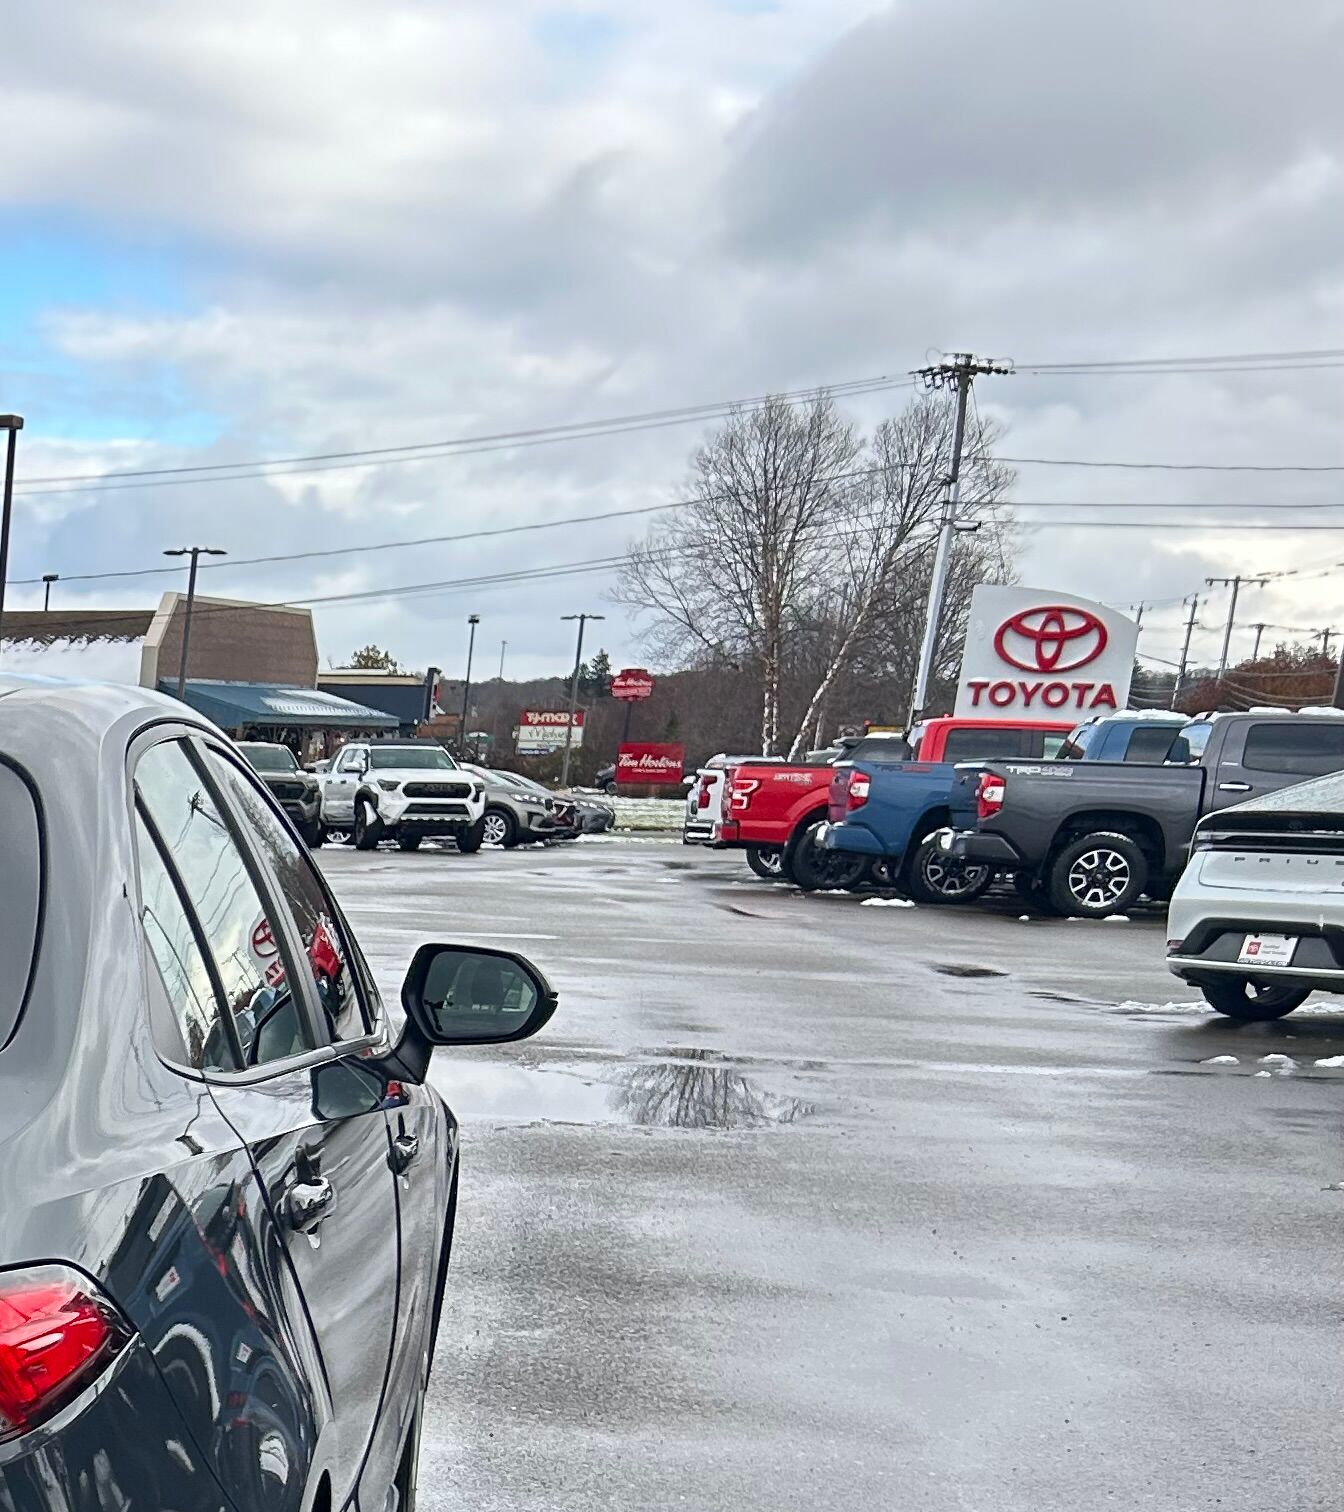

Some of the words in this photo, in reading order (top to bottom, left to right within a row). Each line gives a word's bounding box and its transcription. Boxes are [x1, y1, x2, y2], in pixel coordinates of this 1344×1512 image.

[967, 681, 1117, 709] TOYOTA
[618, 753, 638, 768] Tim
[639, 753, 682, 768] Hortons
